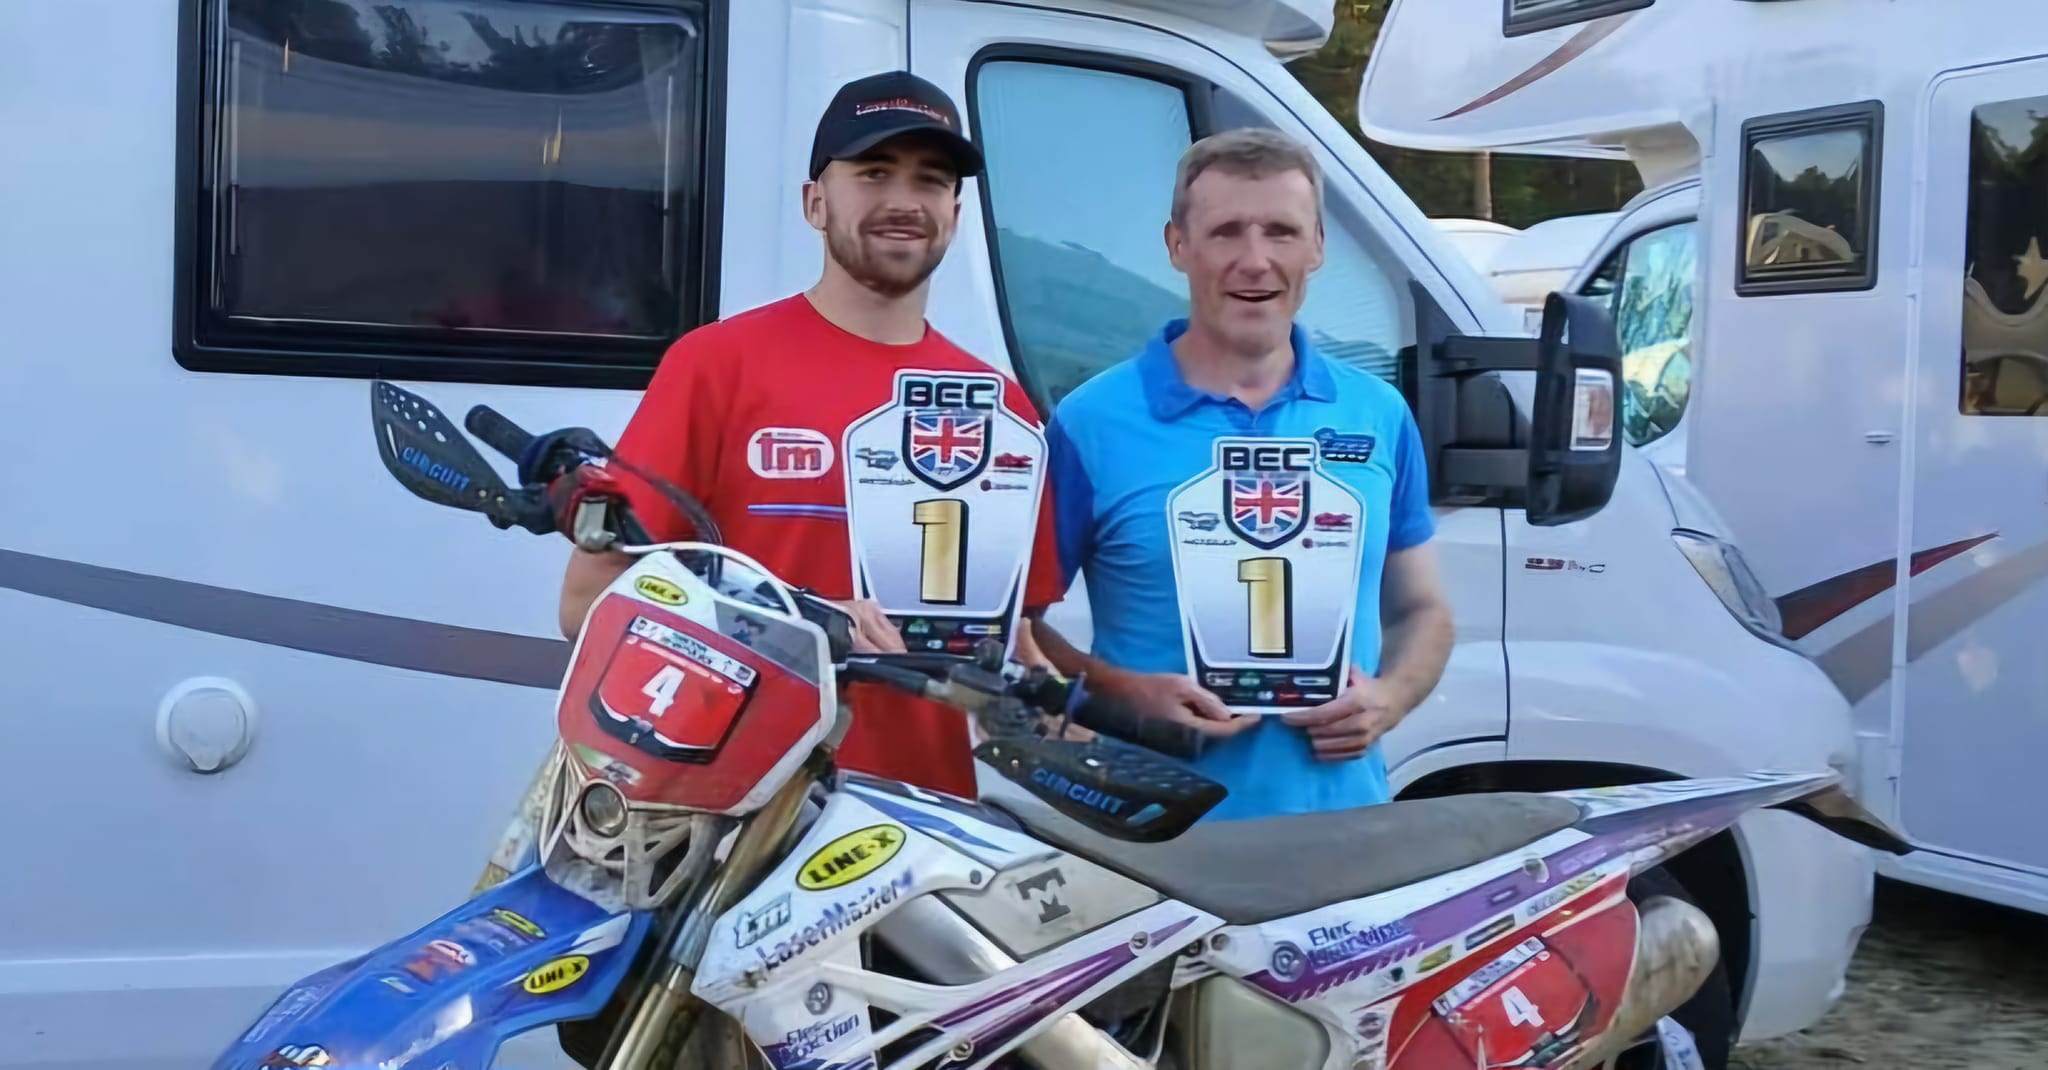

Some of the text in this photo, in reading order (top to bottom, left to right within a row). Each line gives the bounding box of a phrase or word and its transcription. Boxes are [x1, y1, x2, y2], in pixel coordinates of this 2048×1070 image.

[905, 381, 996, 408] BEC
[402, 447, 471, 492] CIRCUIT
[1223, 447, 1312, 471] BEC
[912, 499, 969, 605] 1
[1238, 557, 1293, 658] 1
[641, 664, 686, 717] 4
[1031, 767, 1128, 814] CIRCUIT
[807, 830, 897, 883] LINE-X
[1501, 985, 1545, 1028] 4
